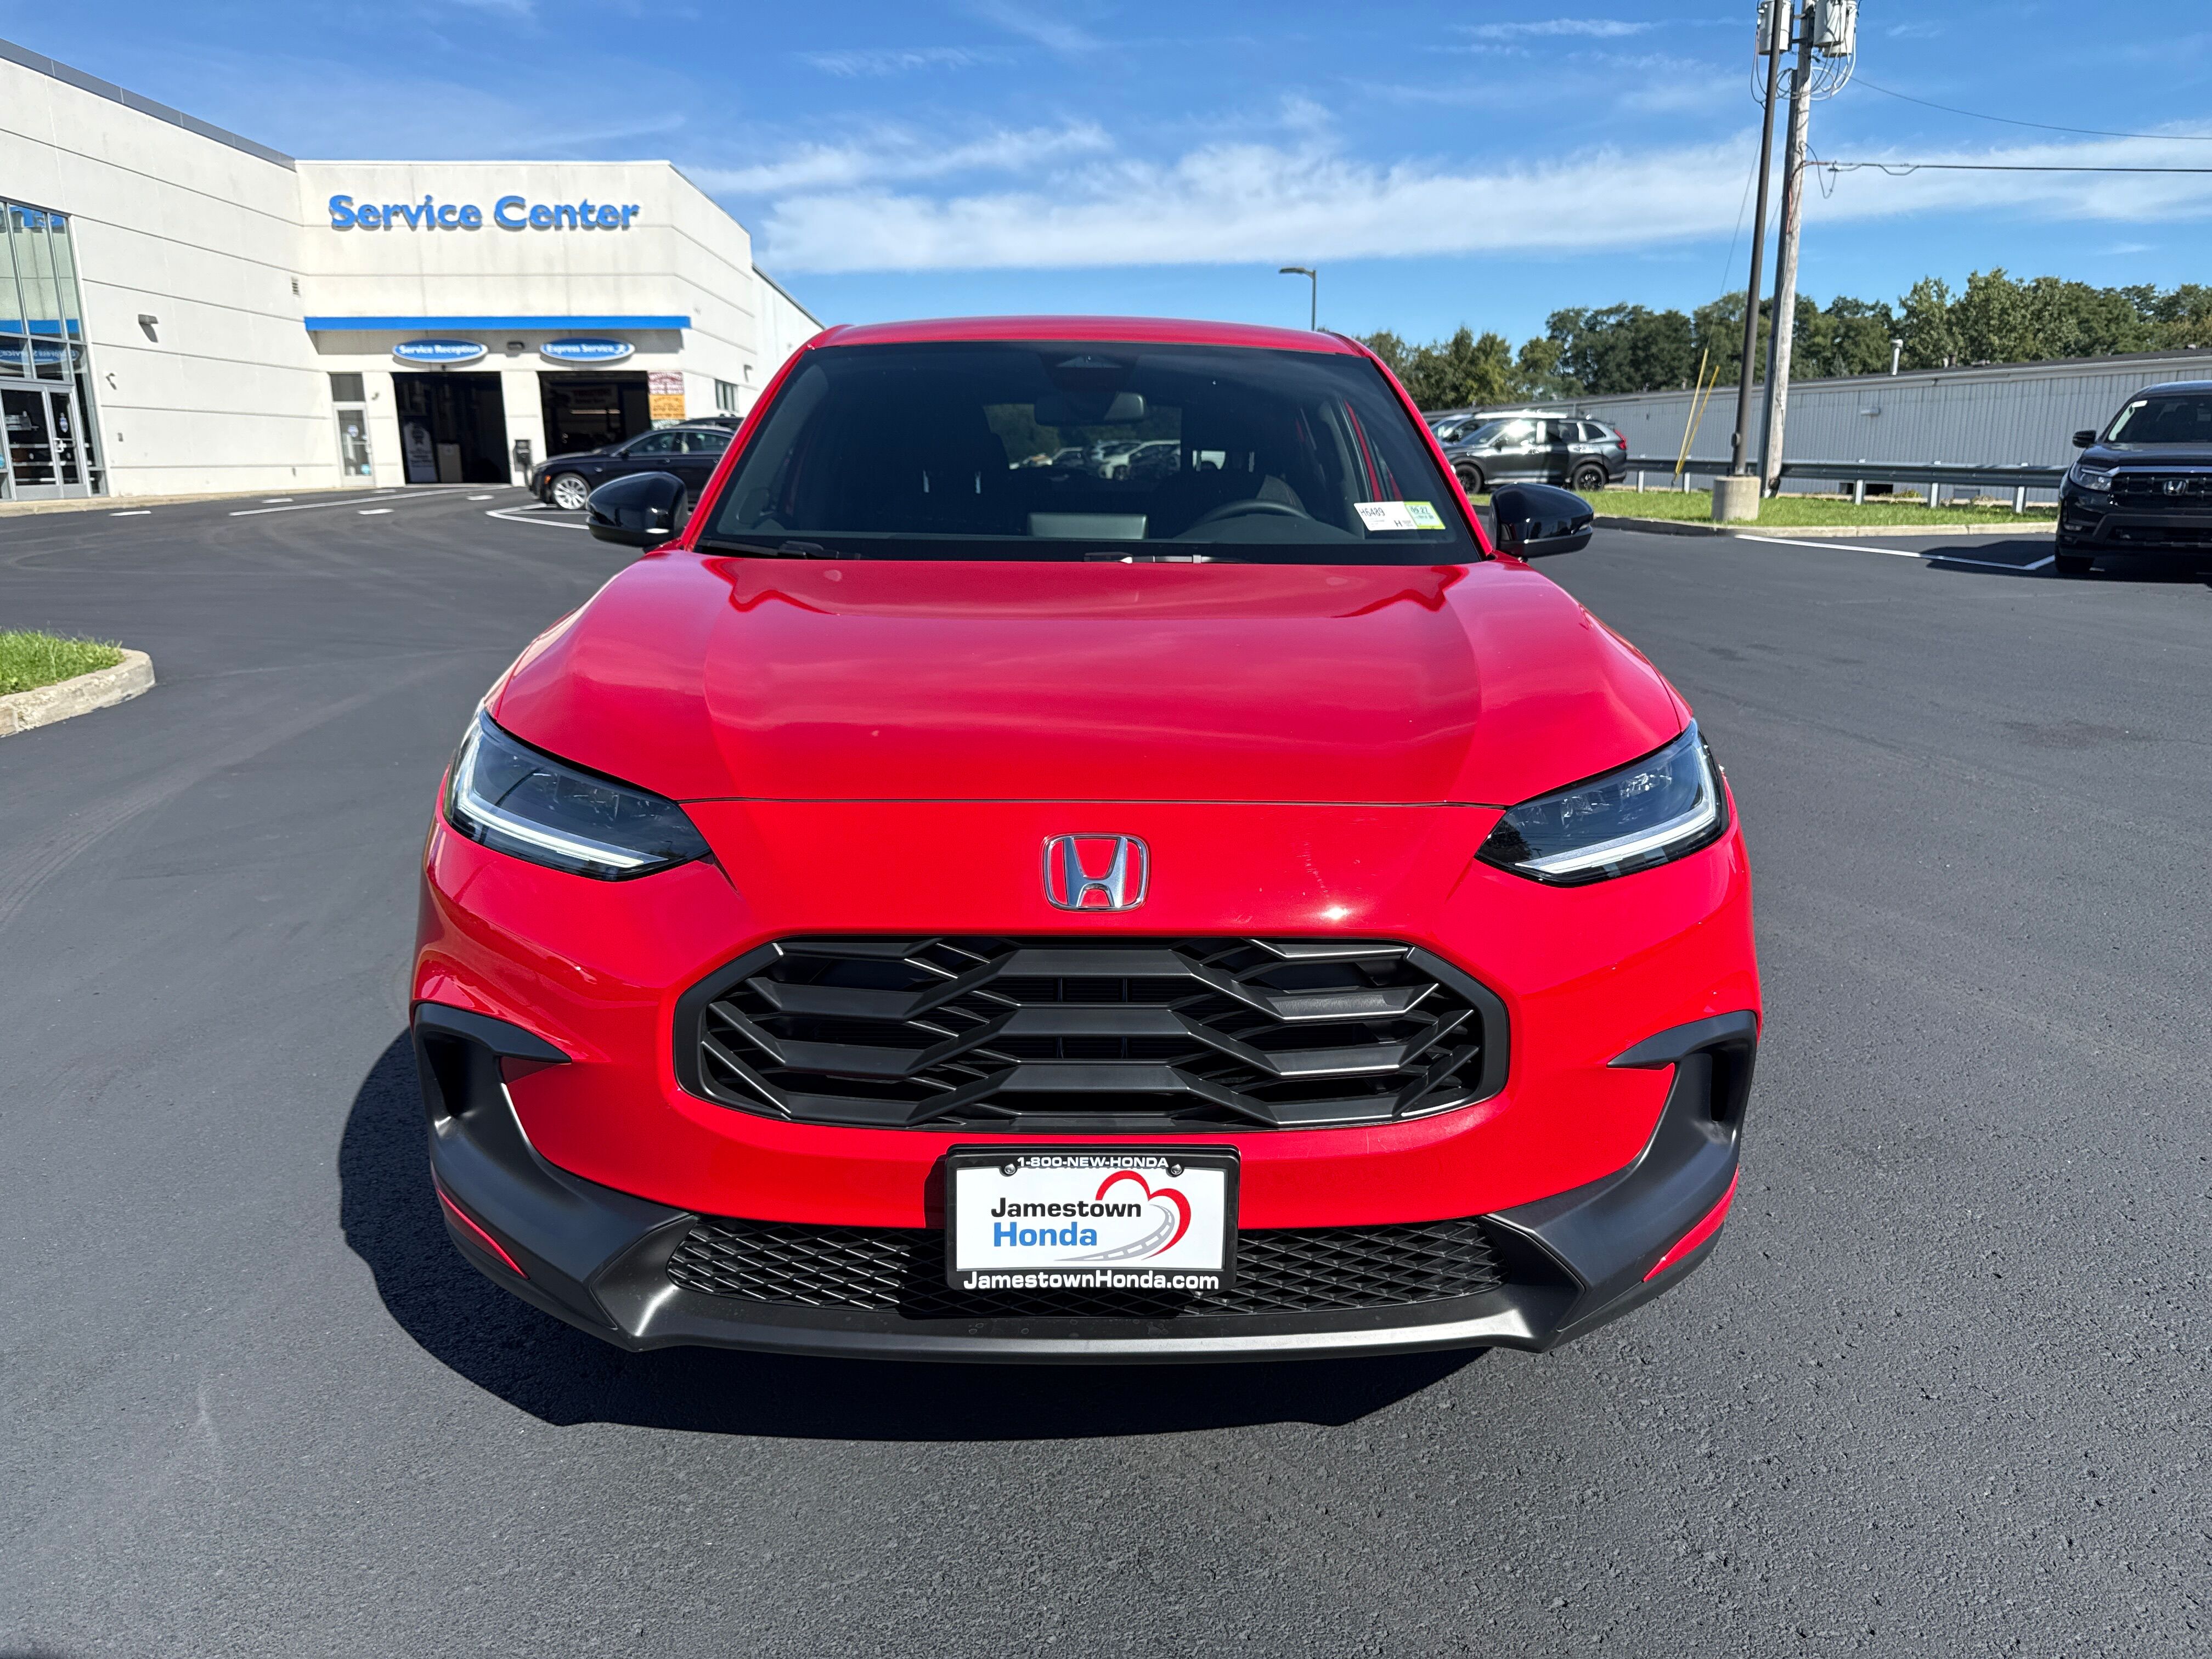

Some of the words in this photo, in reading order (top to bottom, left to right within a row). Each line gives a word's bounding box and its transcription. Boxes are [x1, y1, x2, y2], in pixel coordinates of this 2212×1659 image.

[329, 195, 483, 229] Service
[494, 196, 641, 229] Center
[399, 345, 433, 354] Service
[581, 344, 614, 353] Service
[1358, 507, 1386, 517] H6489
[1017, 1156, 1169, 1167] 1-800-NEW-HONDA
[991, 1197, 1142, 1218] Jamestown
[994, 1221, 1097, 1247] Honda
[963, 1269, 1219, 1290] JamestownHonda.com
